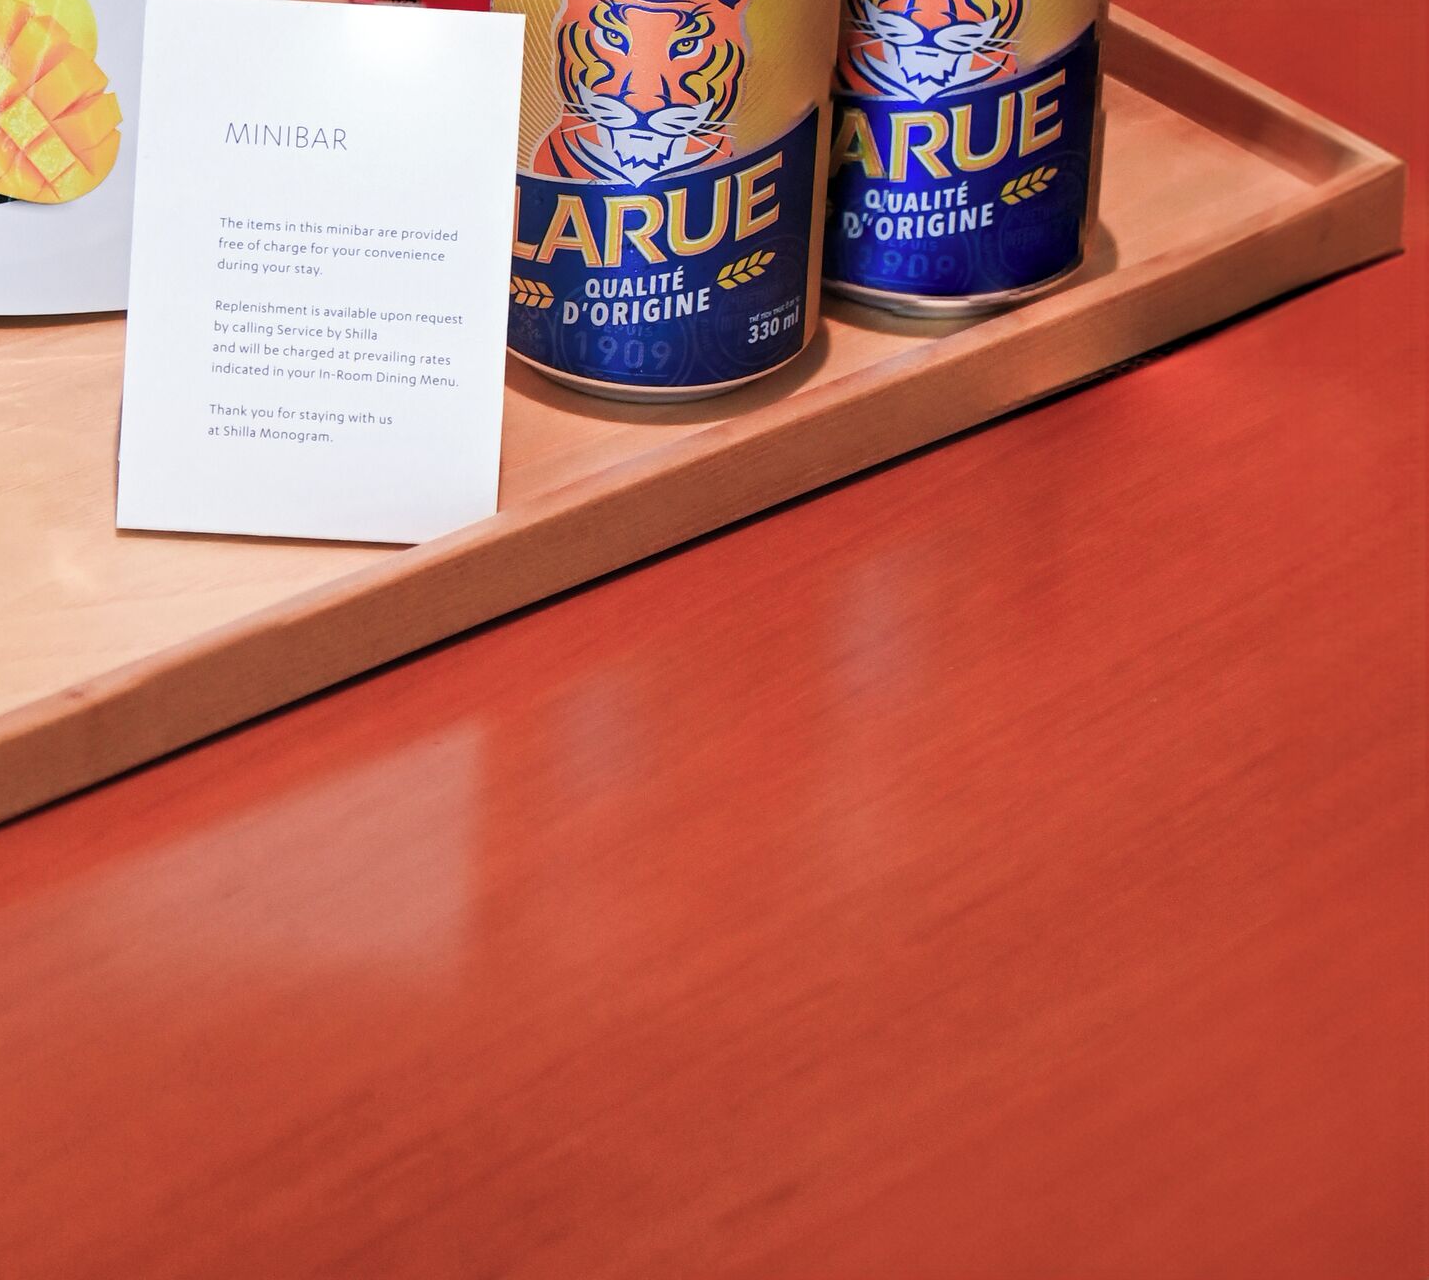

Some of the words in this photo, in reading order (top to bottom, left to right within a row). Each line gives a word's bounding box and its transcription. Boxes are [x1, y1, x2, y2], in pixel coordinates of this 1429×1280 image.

[224, 121, 349, 151] MINIBAR
[830, 68, 1066, 183] ARUE
[512, 151, 783, 268] LARUE
[864, 180, 969, 215] QUALITÉ
[219, 216, 244, 230] The
[246, 218, 282, 232] items
[284, 220, 297, 232] in
[299, 221, 323, 234] this
[326, 223, 376, 237] minibar
[377, 228, 398, 239] are
[401, 228, 459, 242] provided
[218, 236, 244, 250] free
[246, 239, 262, 251] of
[263, 239, 308, 256] charge
[310, 241, 330, 255] for
[331, 247, 361, 260] your
[364, 248, 446, 262] convenience
[217, 257, 259, 275] during
[262, 263, 292, 277] your
[294, 264, 323, 278] stay.
[585, 265, 685, 299] QUALITÉ
[215, 299, 308, 316] Replenishment
[311, 305, 321, 317] is
[323, 306, 377, 320] available
[380, 312, 412, 325] upon
[415, 313, 464, 328] request
[563, 287, 711, 327] D'ORIGINE
[213, 319, 230, 335] by
[231, 321, 274, 338] calling
[276, 324, 324, 338] Service
[326, 325, 342, 341] by
[344, 327, 378, 341] Shilla
[748, 316, 780, 345] 330
[782, 304, 800, 331] ml
[212, 341, 236, 354] and
[239, 342, 261, 355] will
[263, 343, 280, 356] be
[282, 344, 335, 361] charged
[337, 349, 351, 360] at
[353, 350, 416, 367] prevailing
[419, 354, 451, 366] rates
[211, 361, 270, 377] indicated
[272, 365, 284, 377] in
[287, 369, 316, 382] your
[318, 368, 373, 382] In-Room
[376, 371, 417, 388] Dining
[419, 374, 459, 387] Menu.
[209, 403, 248, 417] Thank
[250, 408, 274, 422] you
[277, 406, 297, 420] for
[299, 410, 345, 425] staying
[347, 411, 376, 424] with
[378, 416, 393, 425] us
[207, 426, 220, 436] at
[223, 424, 257, 439] Shilla
[258, 427, 335, 444] Monogram.
